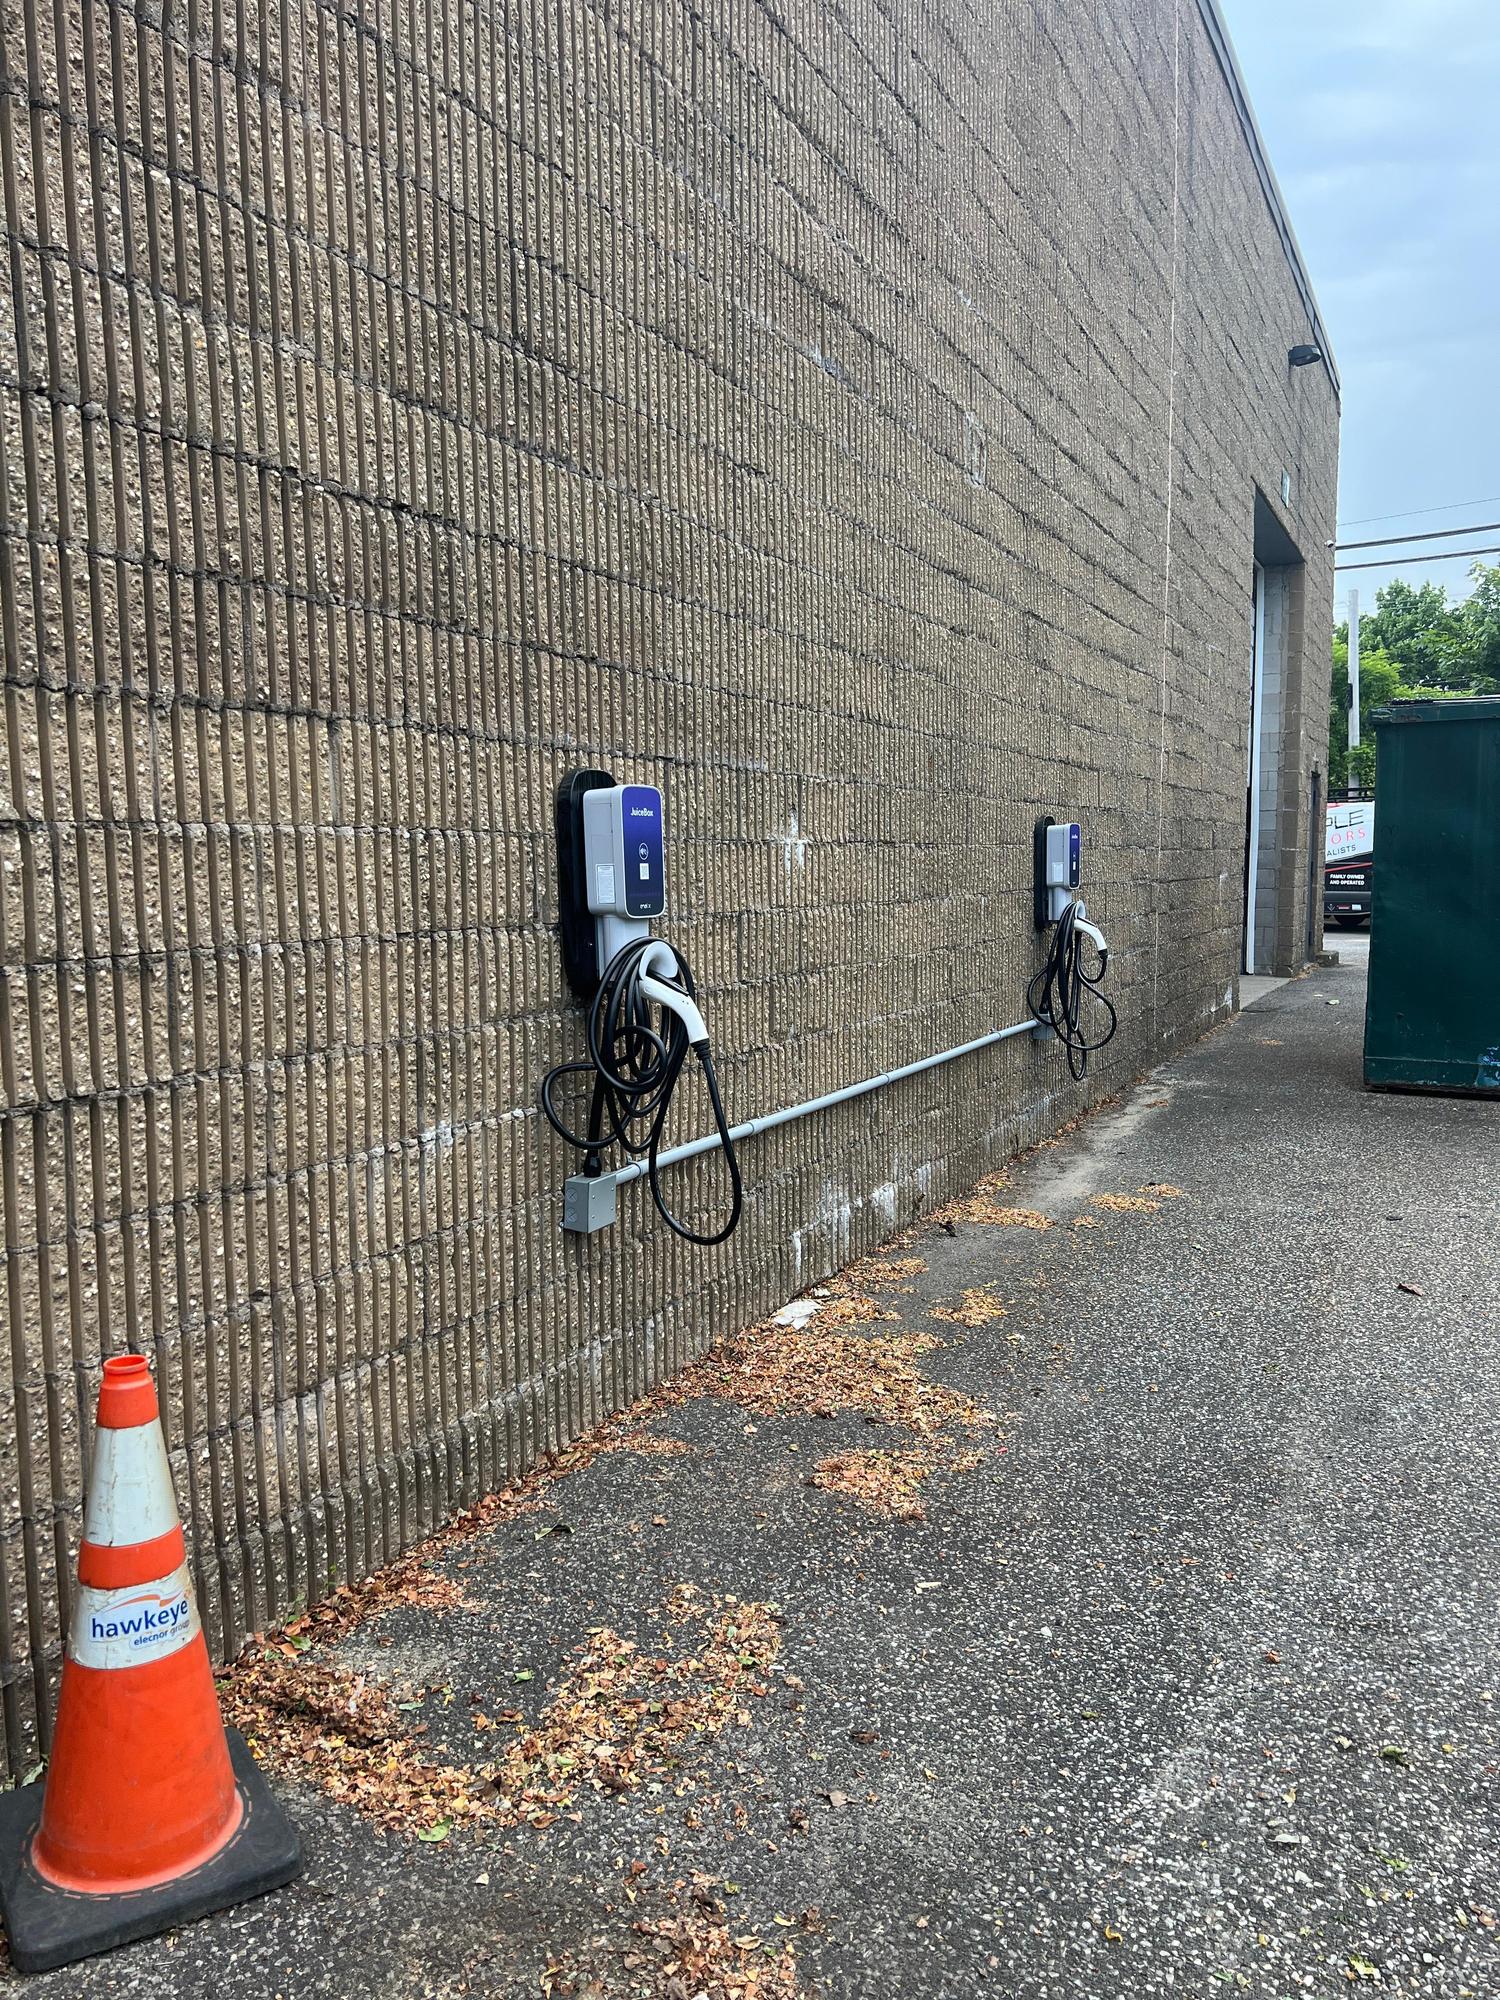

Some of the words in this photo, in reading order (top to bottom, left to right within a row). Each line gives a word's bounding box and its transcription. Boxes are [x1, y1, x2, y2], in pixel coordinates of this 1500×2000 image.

[630, 807, 654, 817] JuiceBox
[91, 1599, 189, 1639] hawkeye
[133, 1629, 168, 1646] elecnor
